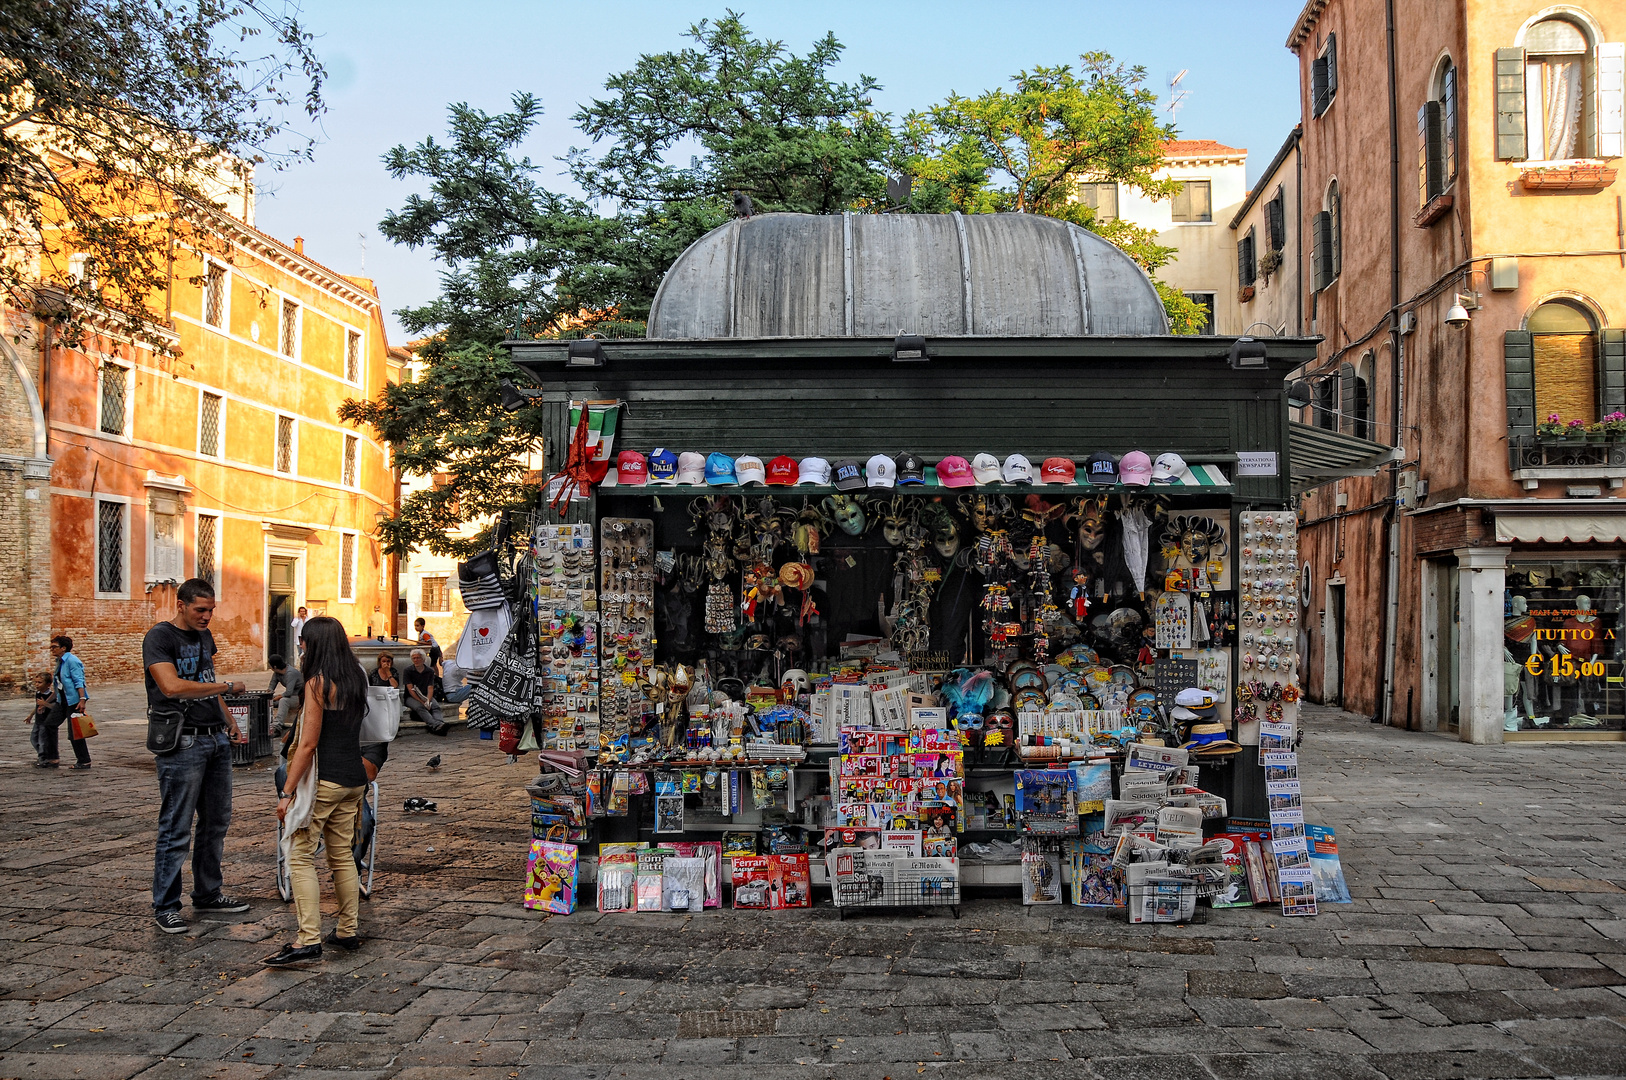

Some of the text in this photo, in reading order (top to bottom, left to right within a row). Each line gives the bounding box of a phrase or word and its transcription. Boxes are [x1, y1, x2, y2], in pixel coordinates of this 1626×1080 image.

[652, 462, 673, 472] ITALIA
[1092, 461, 1114, 474] ITALIA
[837, 464, 860, 481] ITALIA
[1533, 628, 1616, 641] TUTTO A
[1550, 653, 1605, 679] 15,00
[1149, 762, 1175, 771] FIGAR
[1022, 852, 1044, 862] Arte
[1168, 867, 1186, 876] DAILY
[855, 872, 868, 882] Sex
